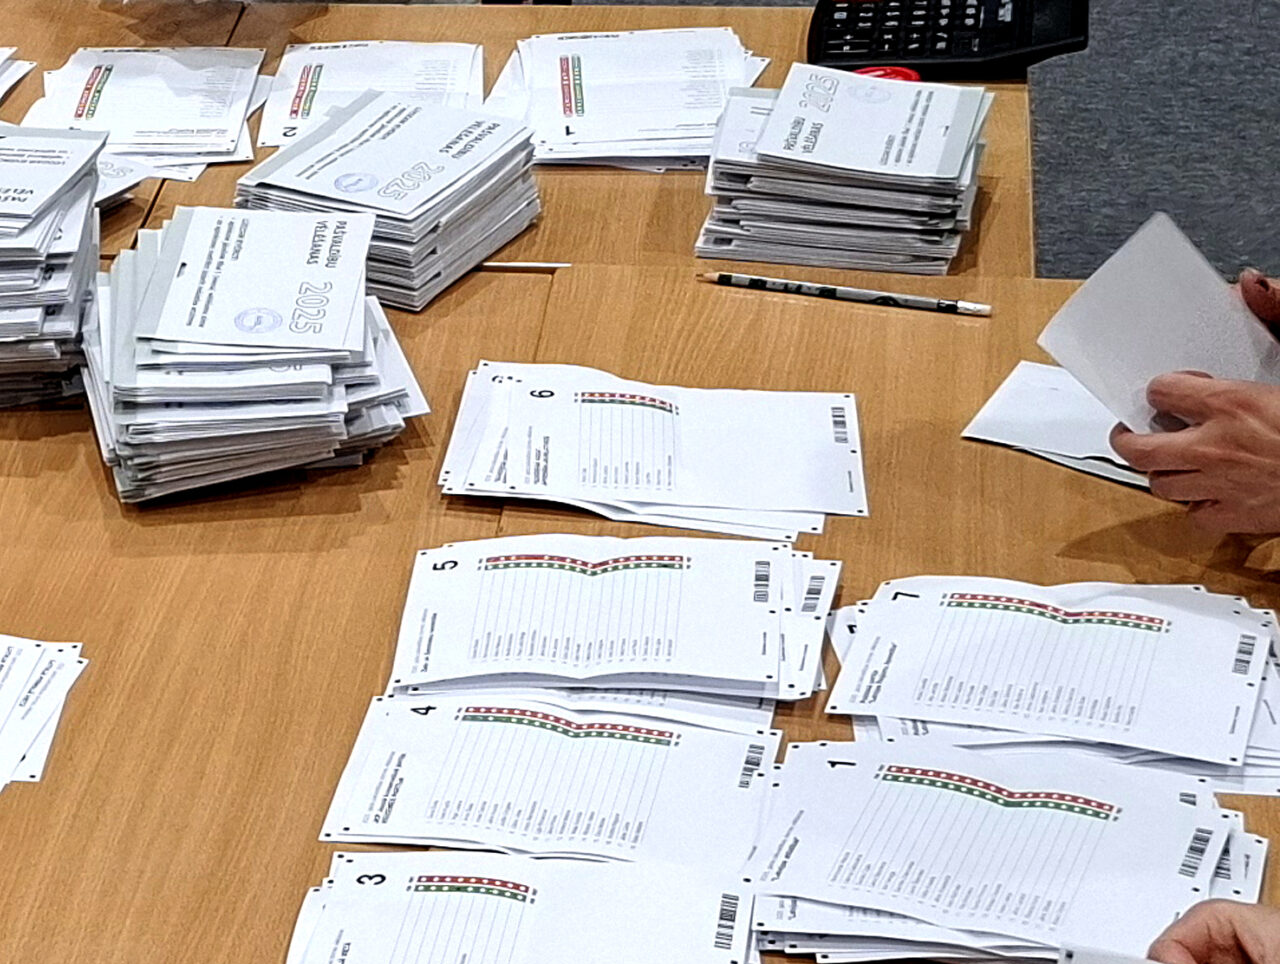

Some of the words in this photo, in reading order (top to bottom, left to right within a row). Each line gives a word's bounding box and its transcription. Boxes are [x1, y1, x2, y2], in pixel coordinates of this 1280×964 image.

[282, 126, 298, 137] 2
[289, 281, 333, 334] 2025
[530, 389, 554, 399] 6
[432, 559, 458, 572] 5
[892, 591, 920, 601] 7
[410, 705, 437, 717] 4
[356, 872, 387, 887] 3
